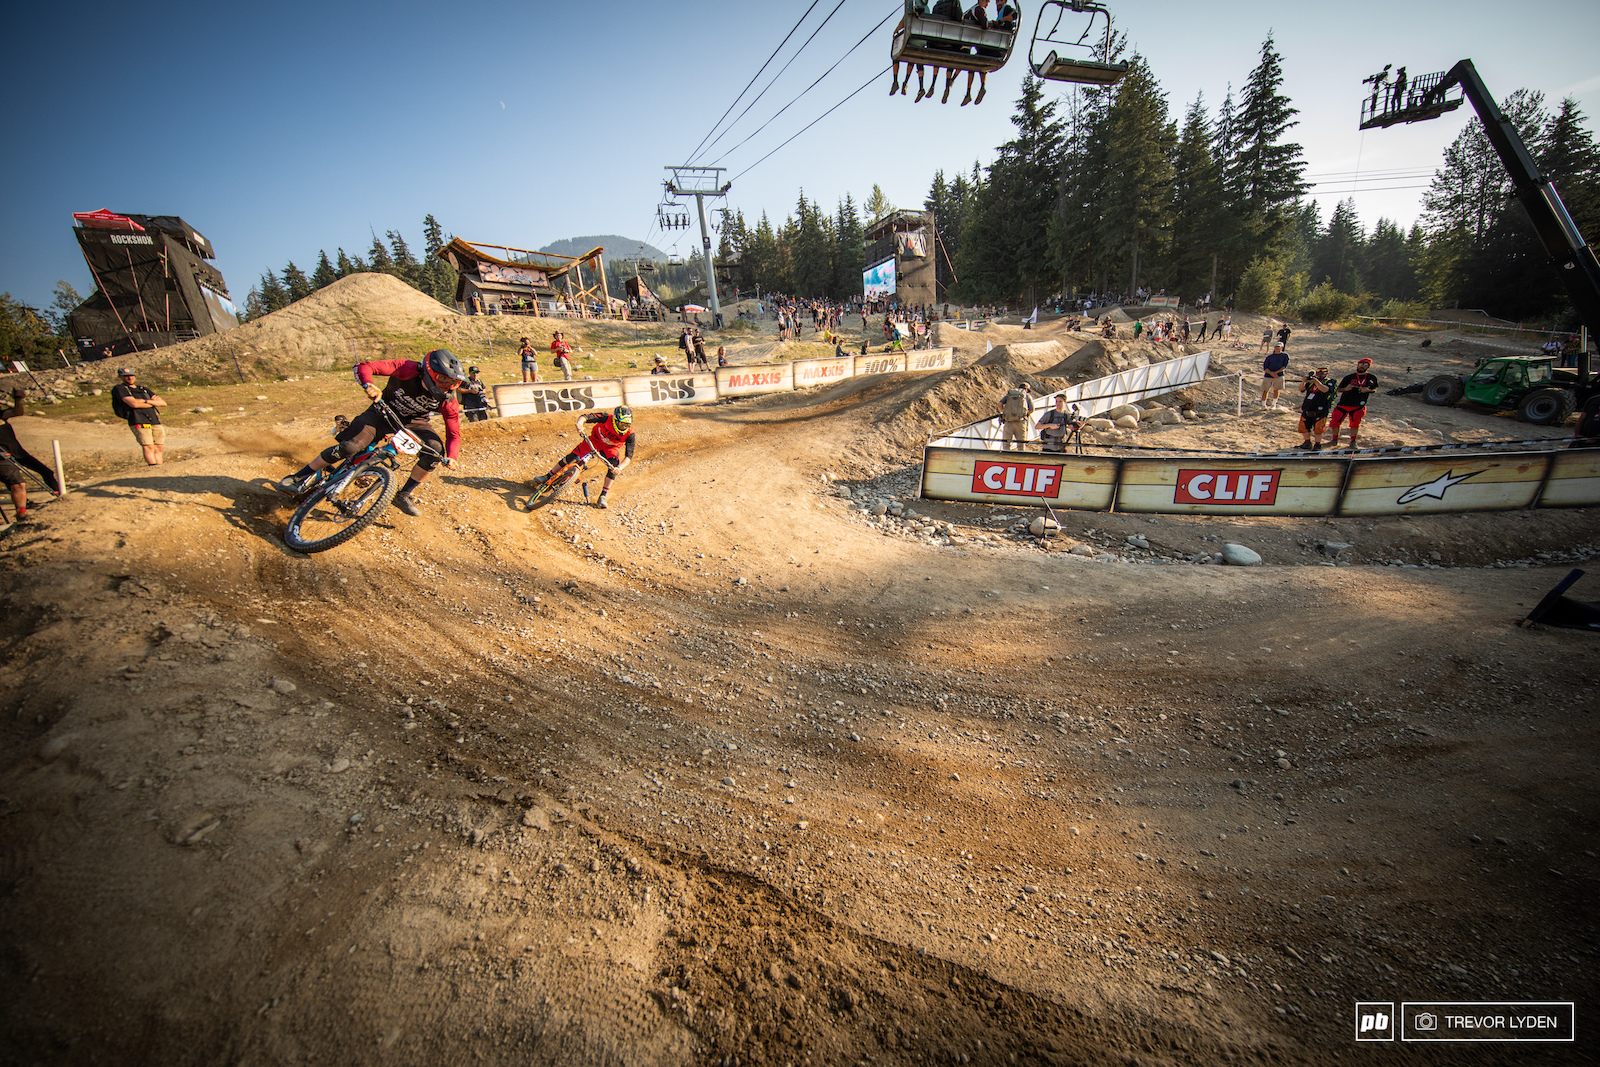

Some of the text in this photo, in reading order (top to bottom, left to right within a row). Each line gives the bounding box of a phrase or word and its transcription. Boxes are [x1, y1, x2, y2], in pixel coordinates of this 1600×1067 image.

[110, 234, 153, 245] ROCKSHOX
[864, 358, 898, 375] 100%
[915, 353, 946, 370] 100%
[728, 371, 782, 388] MAXXIS
[803, 364, 845, 380] MAXXIS
[982, 465, 1057, 493] CLIF
[1187, 473, 1273, 501] CLIF
